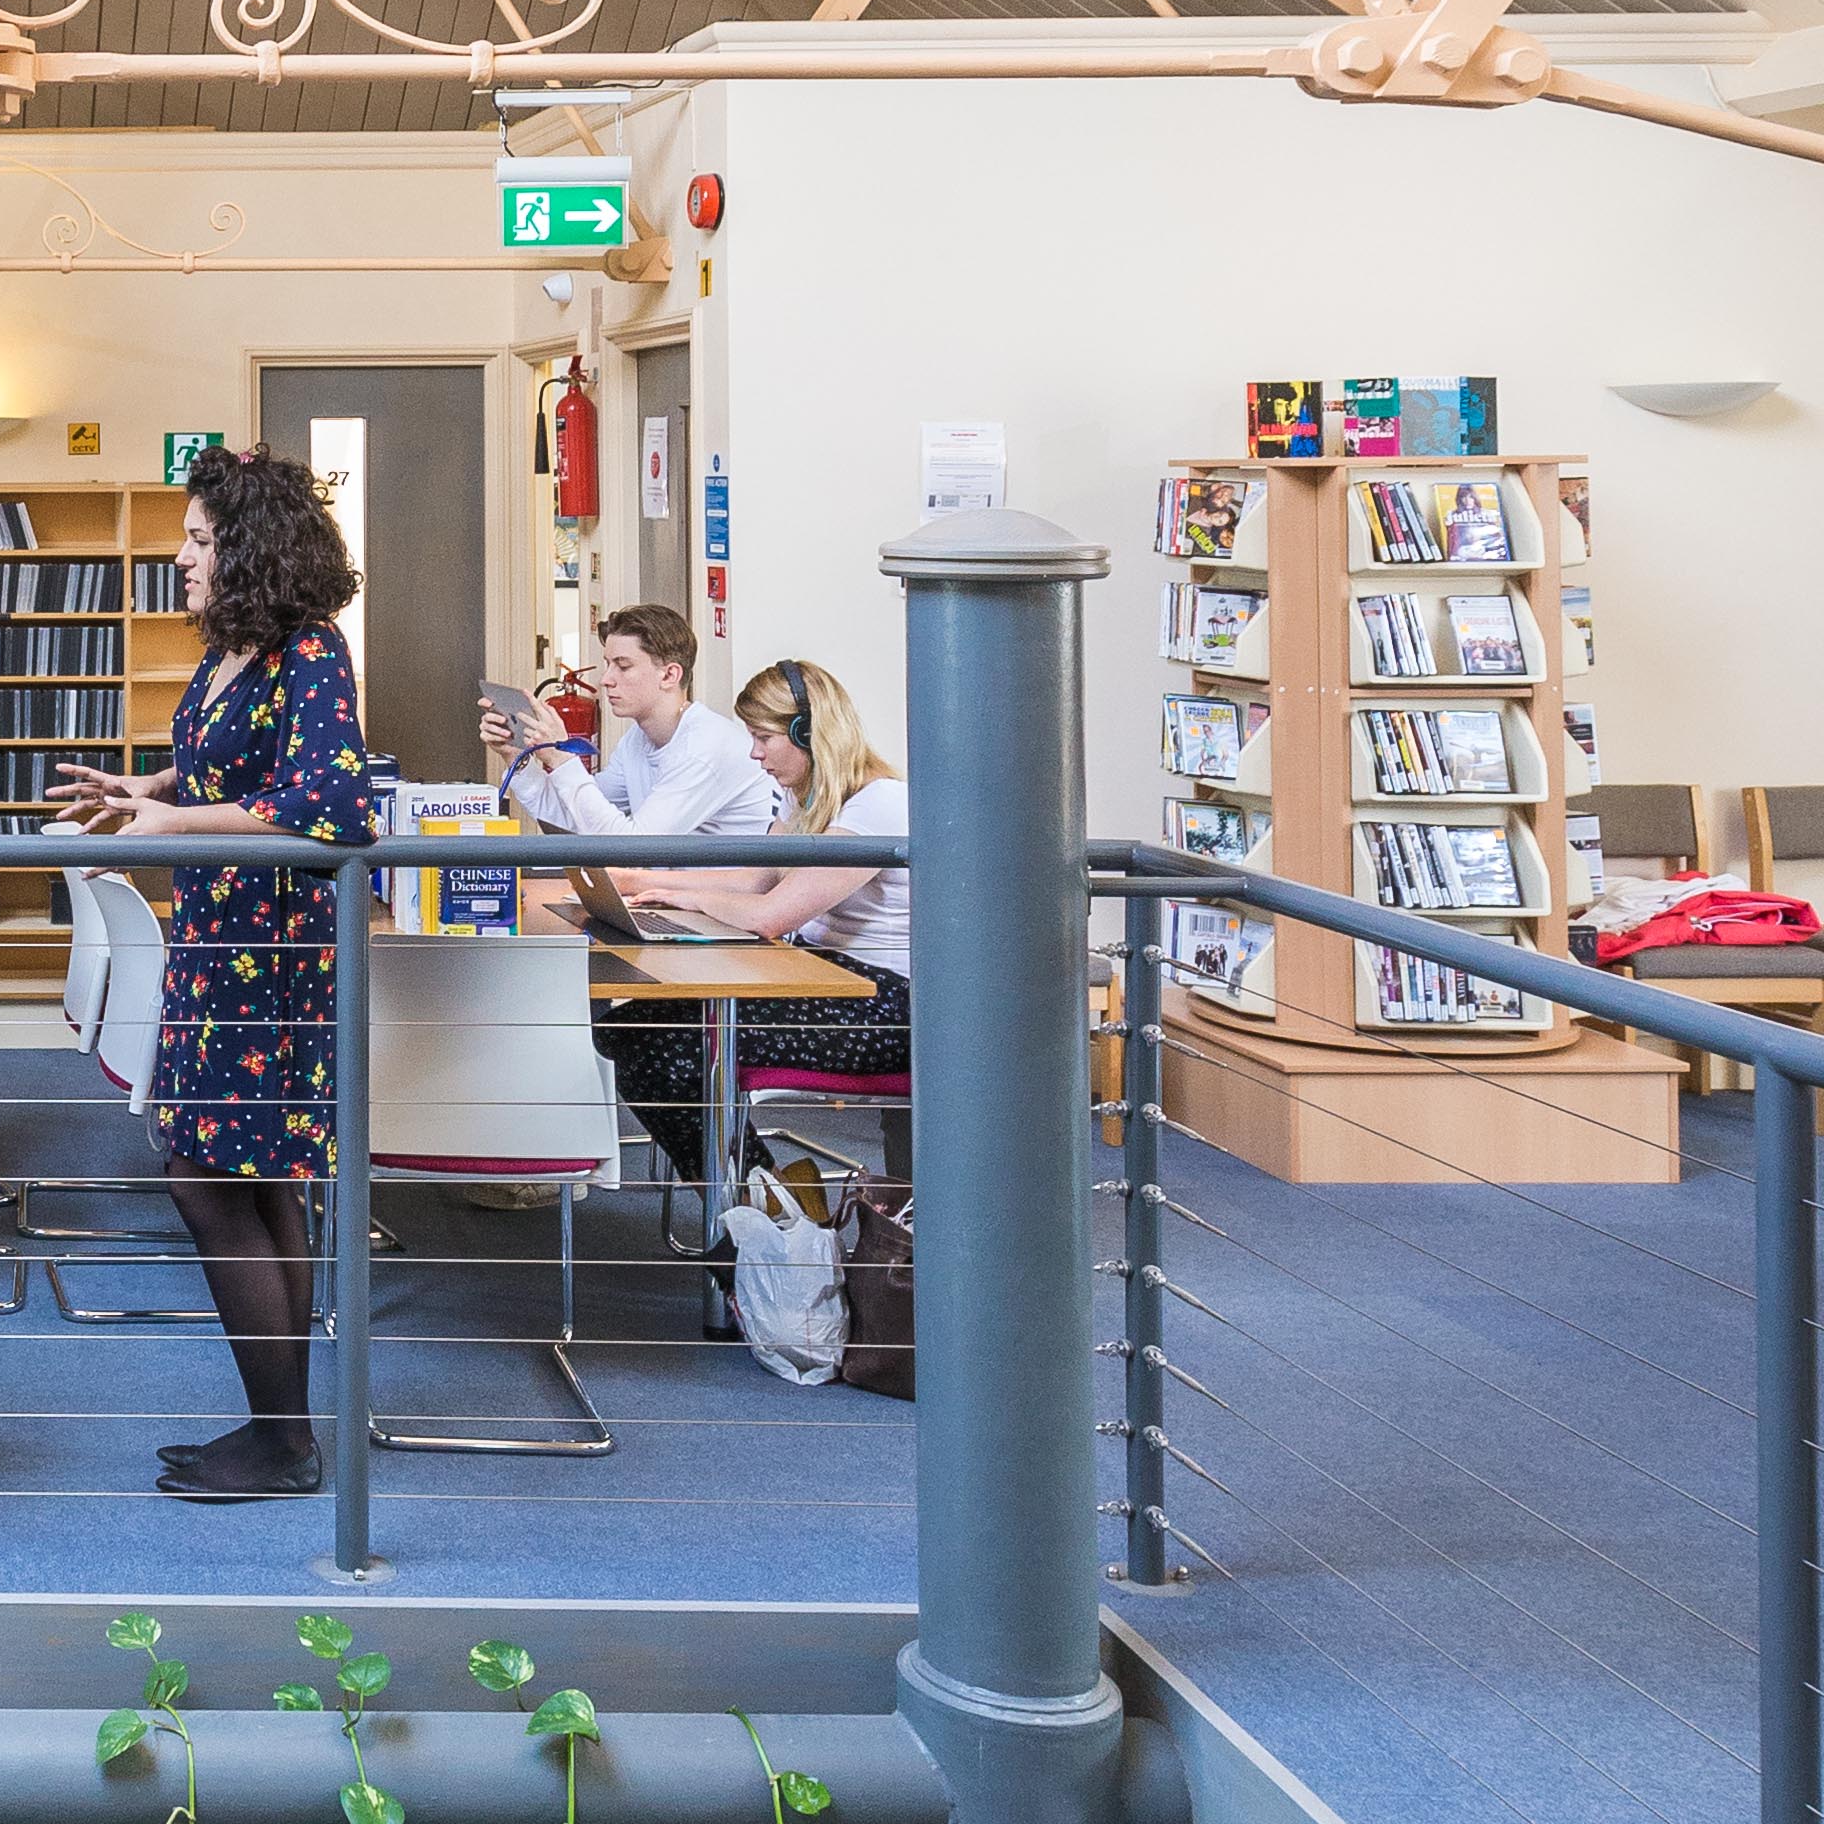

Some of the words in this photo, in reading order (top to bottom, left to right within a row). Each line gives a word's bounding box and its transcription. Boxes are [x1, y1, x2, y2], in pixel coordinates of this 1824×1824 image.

[327, 471, 350, 486] 27
[411, 803, 491, 817] LAROUSSE
[449, 869, 511, 881] CHINESE
[451, 881, 509, 894] Dictionary
